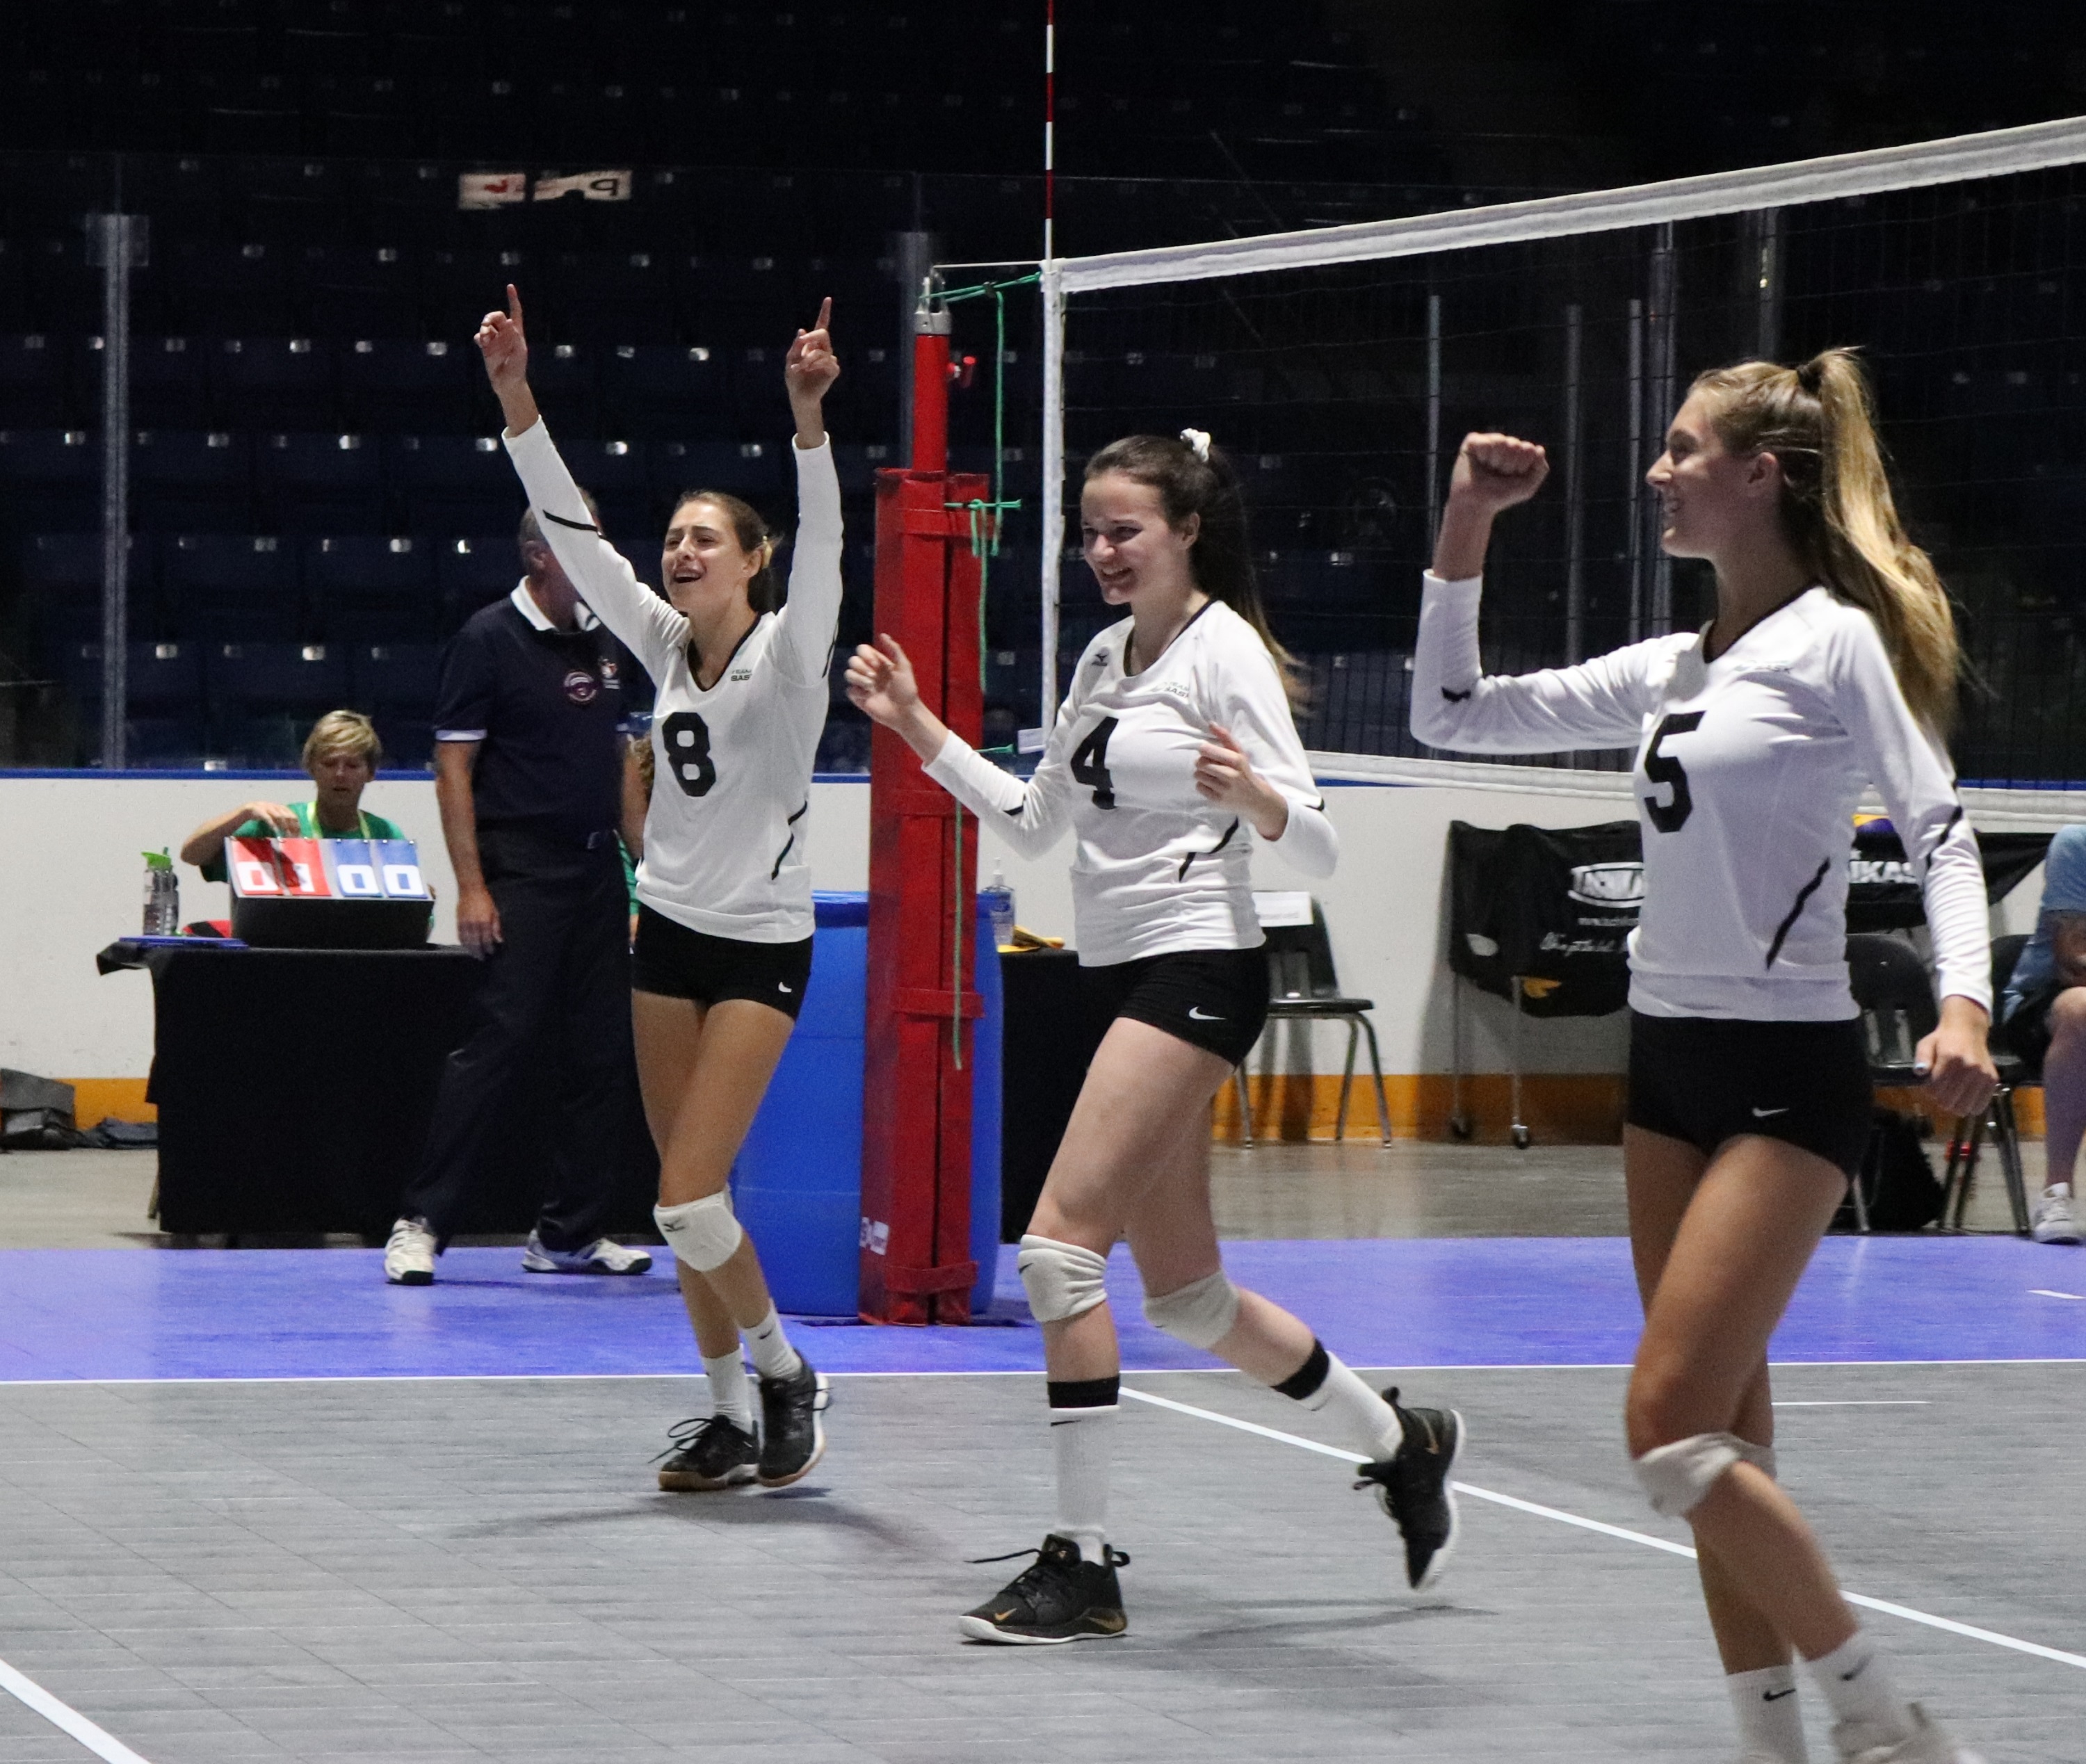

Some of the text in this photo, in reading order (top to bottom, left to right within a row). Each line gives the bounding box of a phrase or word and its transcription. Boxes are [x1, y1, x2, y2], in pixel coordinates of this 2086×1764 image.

[662, 712, 716, 797] 8
[1070, 716, 1119, 810] 4
[1644, 710, 1706, 833] 5
